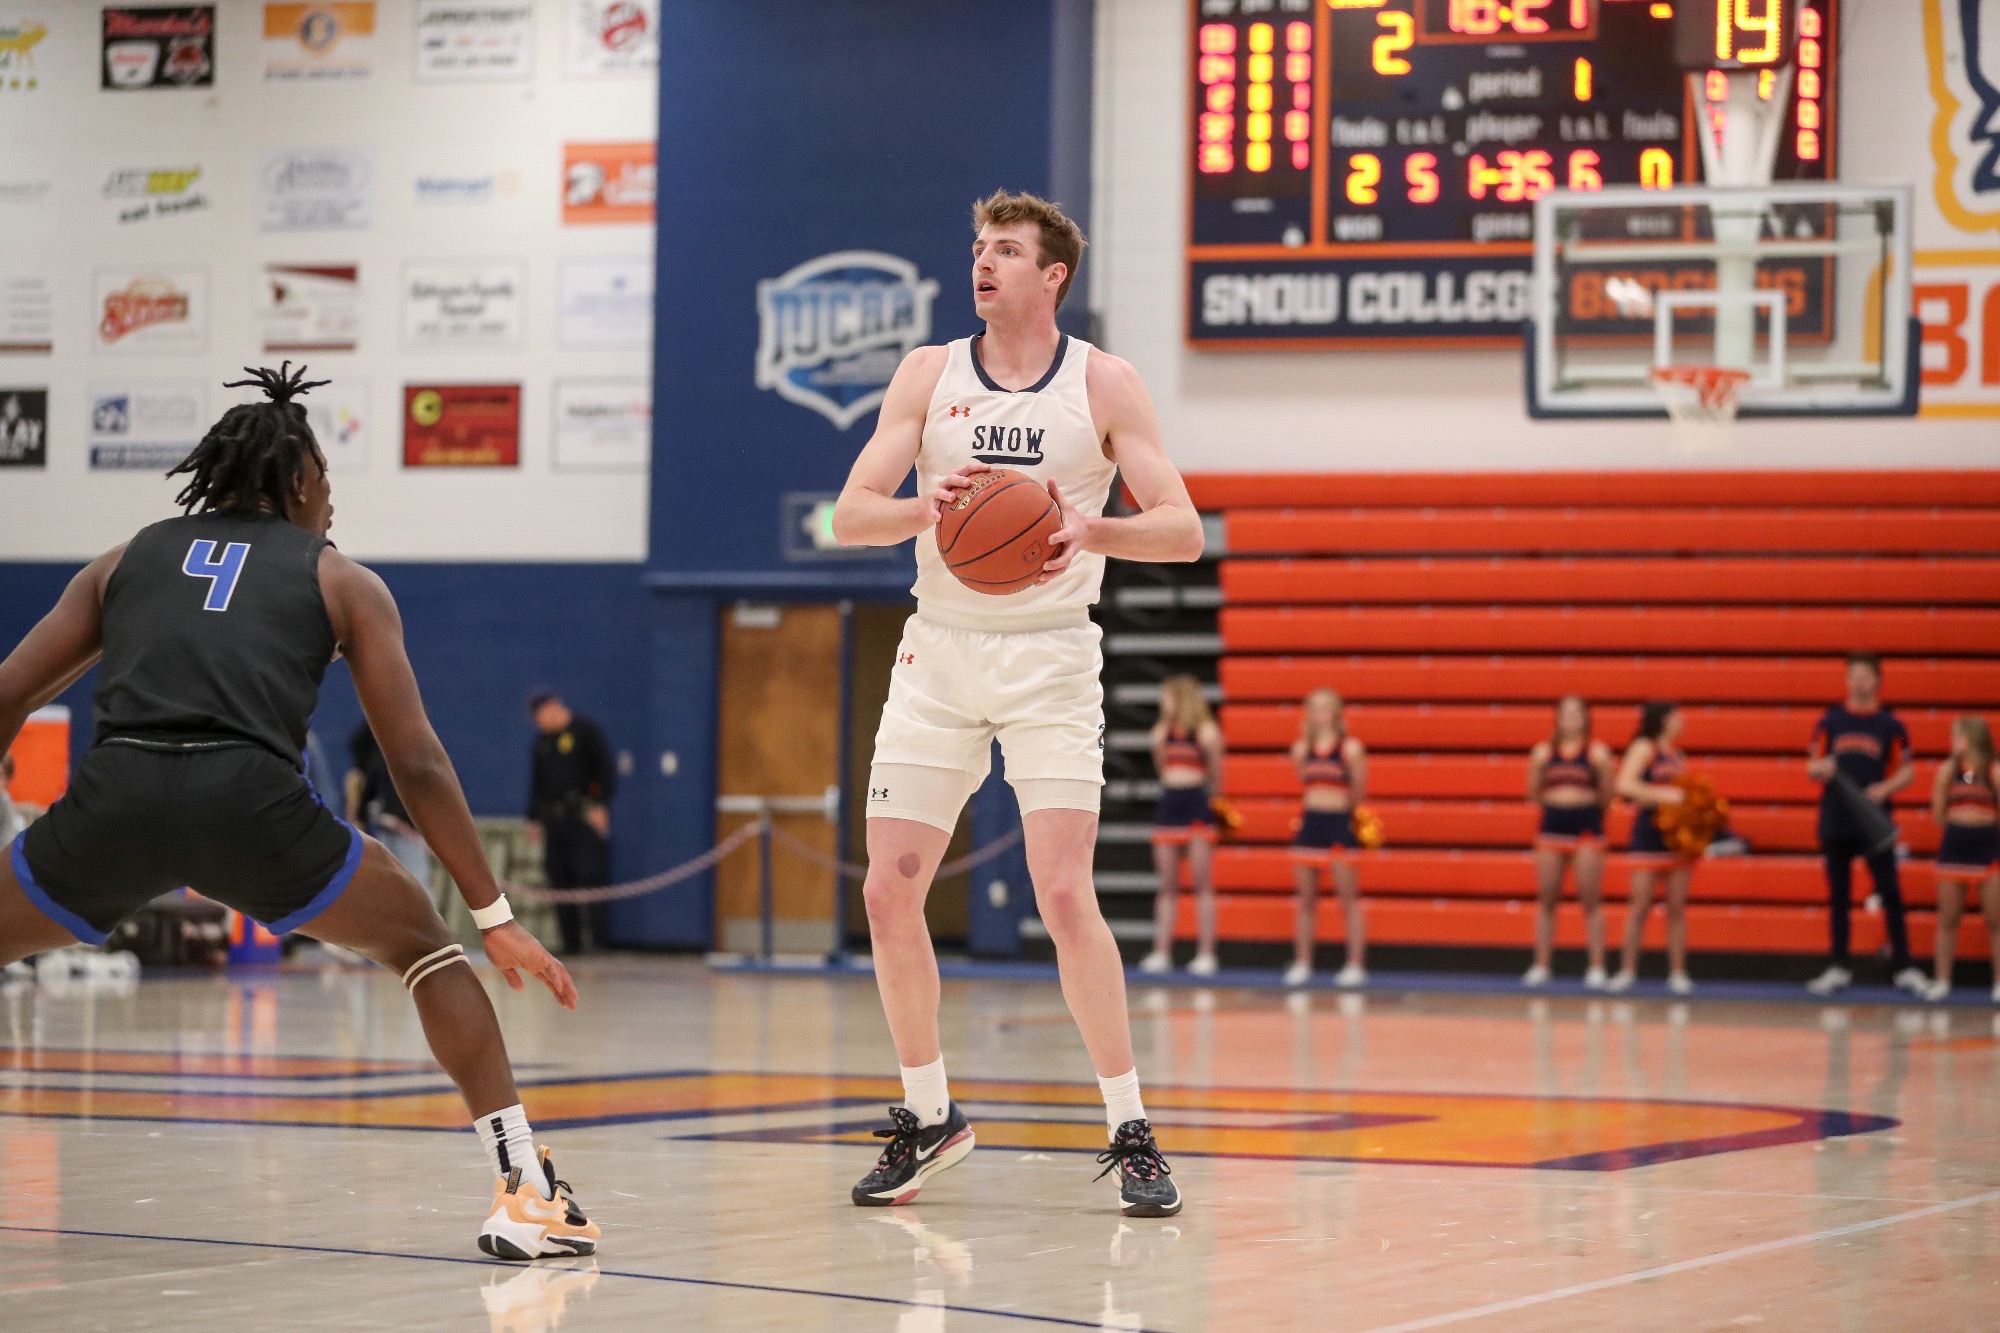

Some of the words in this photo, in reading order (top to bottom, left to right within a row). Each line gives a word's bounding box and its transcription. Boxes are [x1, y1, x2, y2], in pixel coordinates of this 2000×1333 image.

[1373, 11, 1414, 75] 2
[1716, 0, 1780, 63] 19
[1575, 58, 1592, 102] 1
[1346, 153, 1381, 204] 2
[1405, 152, 1440, 203] 5
[1202, 272, 1340, 325] SNOW
[972, 425, 1045, 455] SNOW
[182, 539, 251, 611] 4
